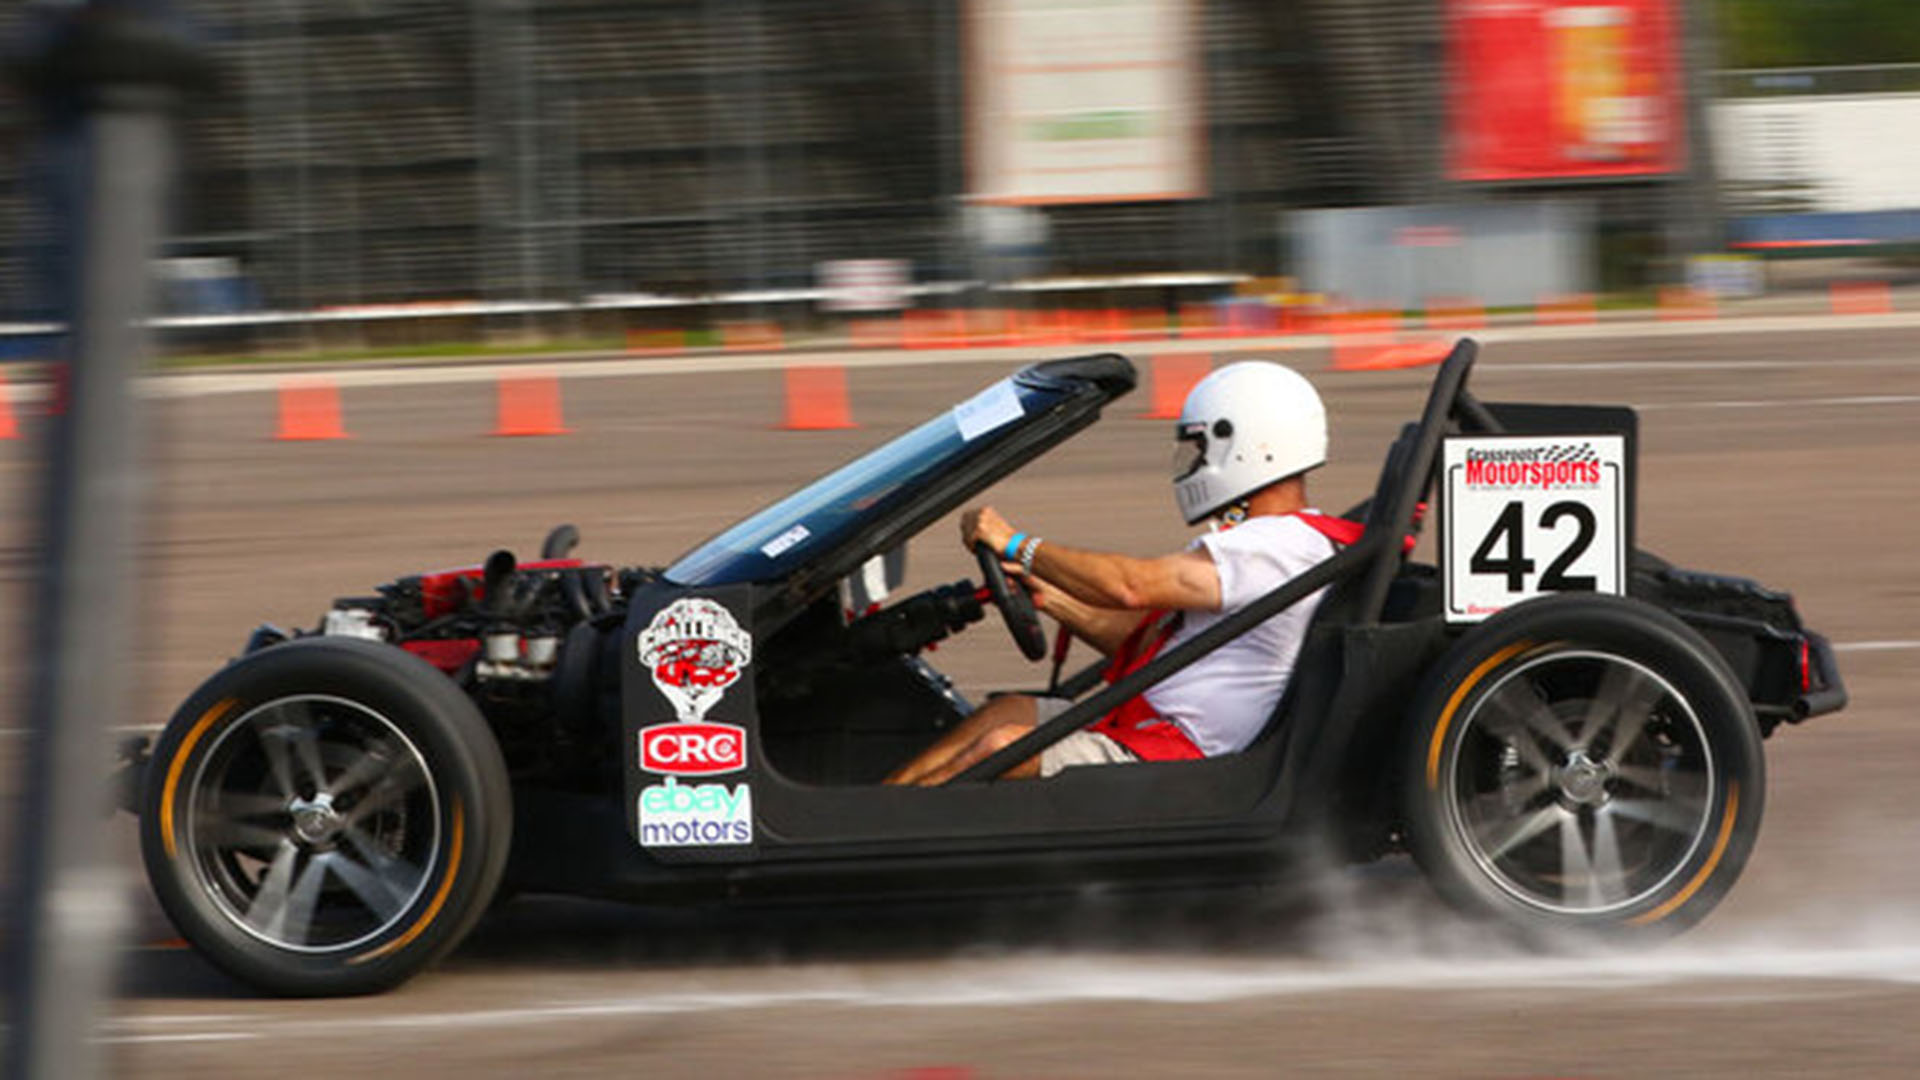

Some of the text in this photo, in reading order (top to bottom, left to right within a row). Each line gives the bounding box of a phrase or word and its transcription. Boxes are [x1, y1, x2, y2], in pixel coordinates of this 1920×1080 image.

[1467, 448, 1541, 461] Grassroots
[1466, 459, 1600, 490] Motorsports
[1470, 500, 1598, 592] 42
[648, 734, 738, 762] CRC
[643, 777, 745, 820] ebay
[643, 819, 749, 843] motors
